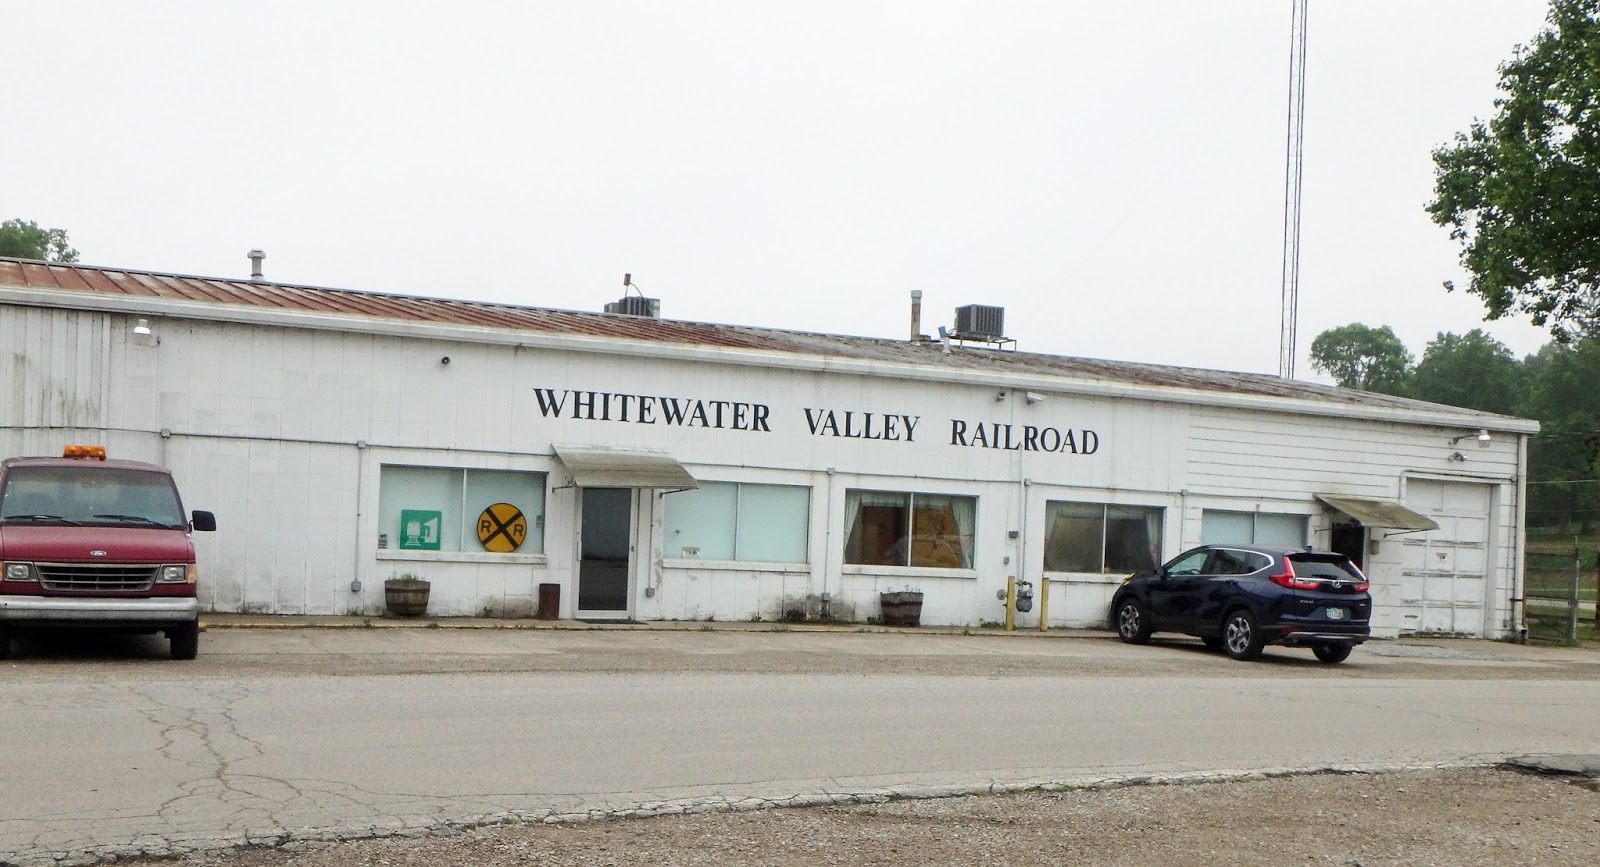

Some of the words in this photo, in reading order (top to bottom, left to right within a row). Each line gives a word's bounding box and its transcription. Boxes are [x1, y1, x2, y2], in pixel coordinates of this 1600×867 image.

[533, 388, 771, 433] WHITEWATER
[804, 408, 920, 442] VALLEY
[950, 419, 1099, 456] RAILROAD
[481, 520, 491, 533] R
[513, 524, 524, 536] R
